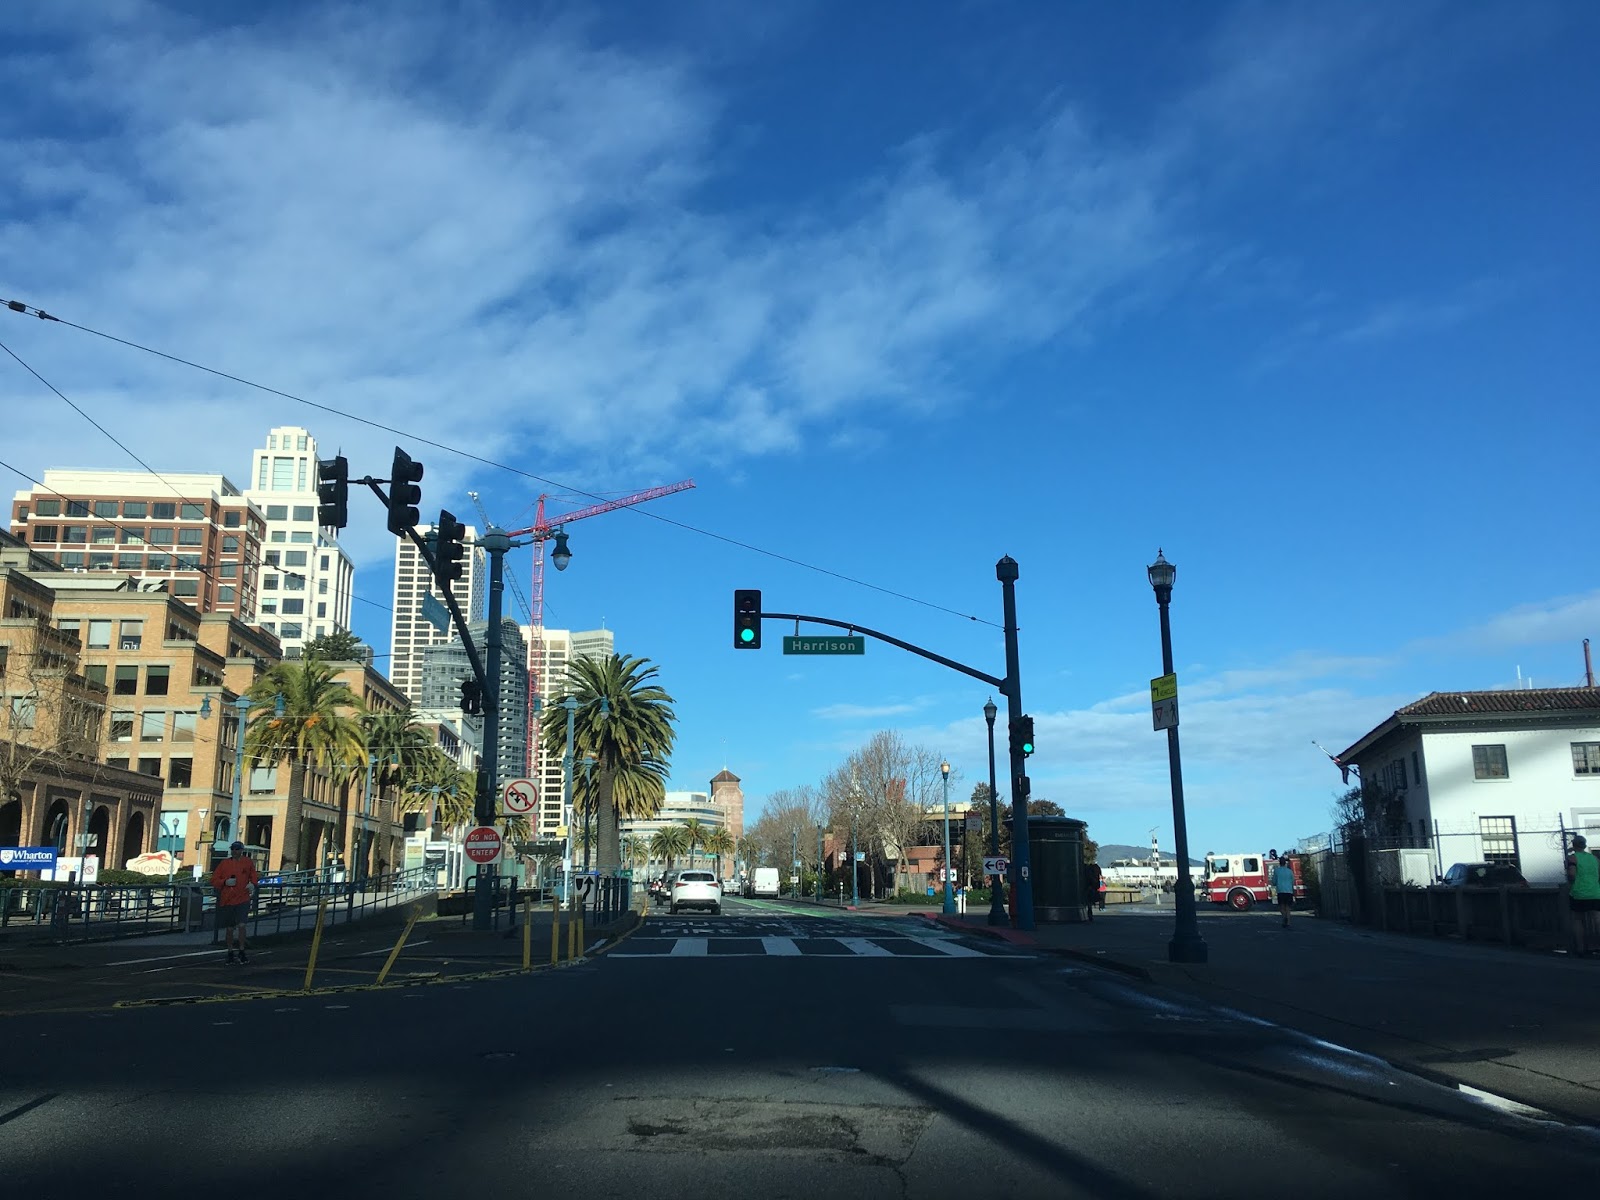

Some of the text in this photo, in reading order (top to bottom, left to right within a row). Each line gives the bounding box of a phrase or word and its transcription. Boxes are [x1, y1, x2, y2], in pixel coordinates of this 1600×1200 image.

[792, 640, 855, 651] Harrison
[484, 833, 497, 841] NOT
[13, 849, 53, 860] Wharton
